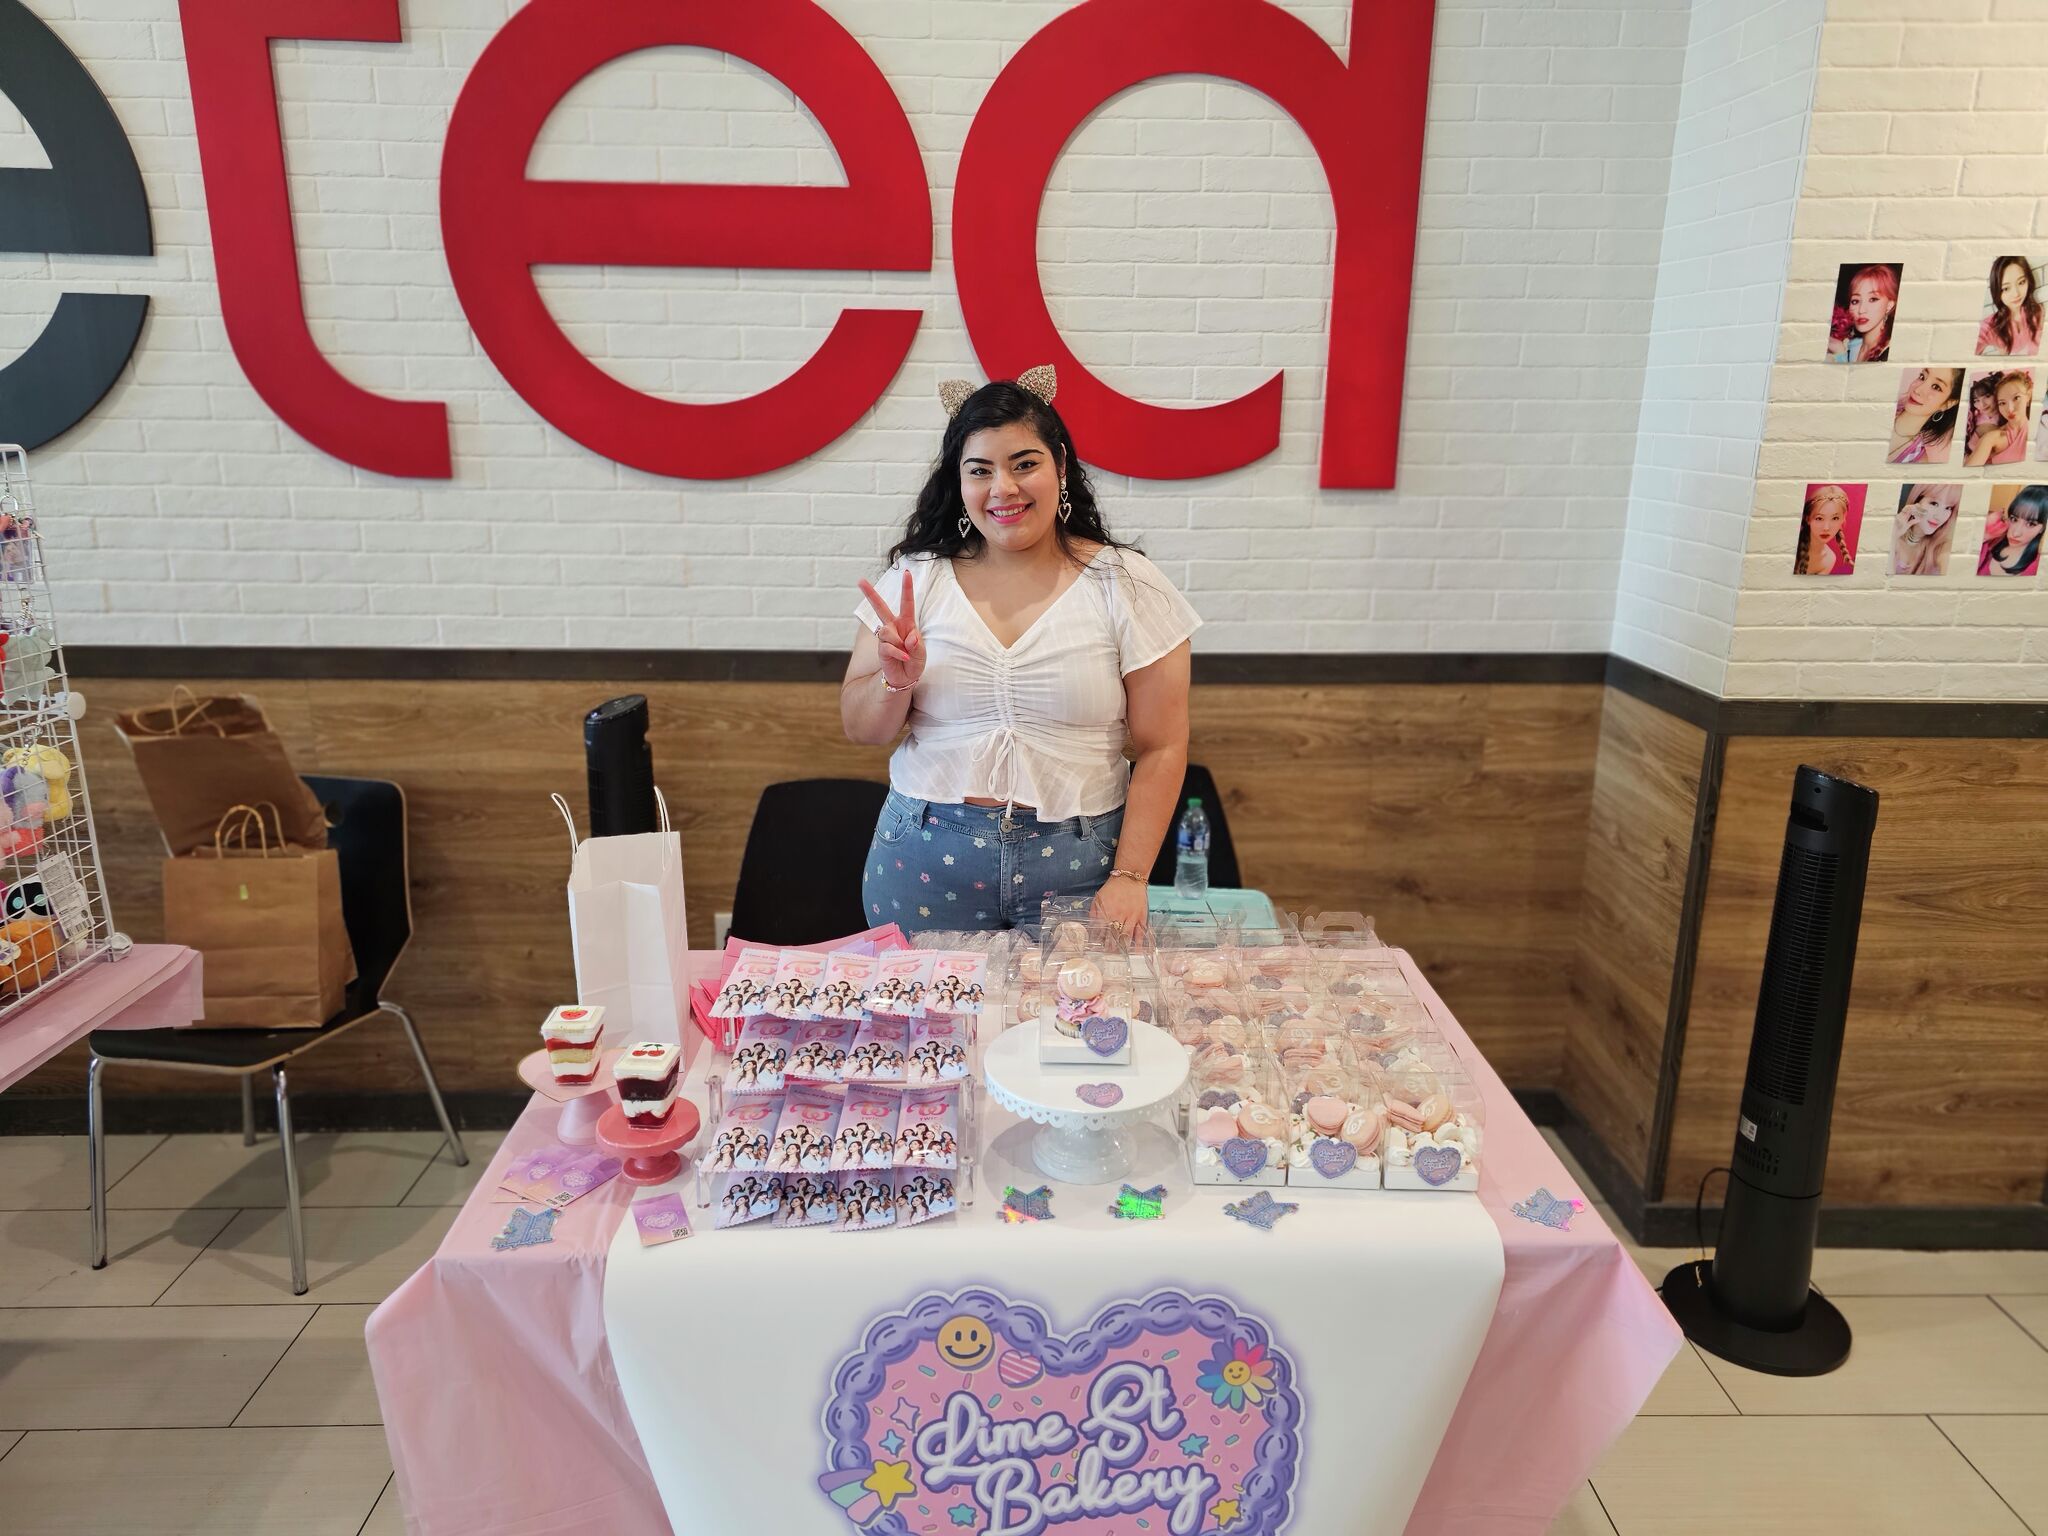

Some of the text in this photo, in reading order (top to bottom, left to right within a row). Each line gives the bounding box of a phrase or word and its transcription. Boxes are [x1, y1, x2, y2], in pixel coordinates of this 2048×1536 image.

[913, 1360, 1187, 1493] Lime St
[972, 1441, 1222, 1536] Bakery
